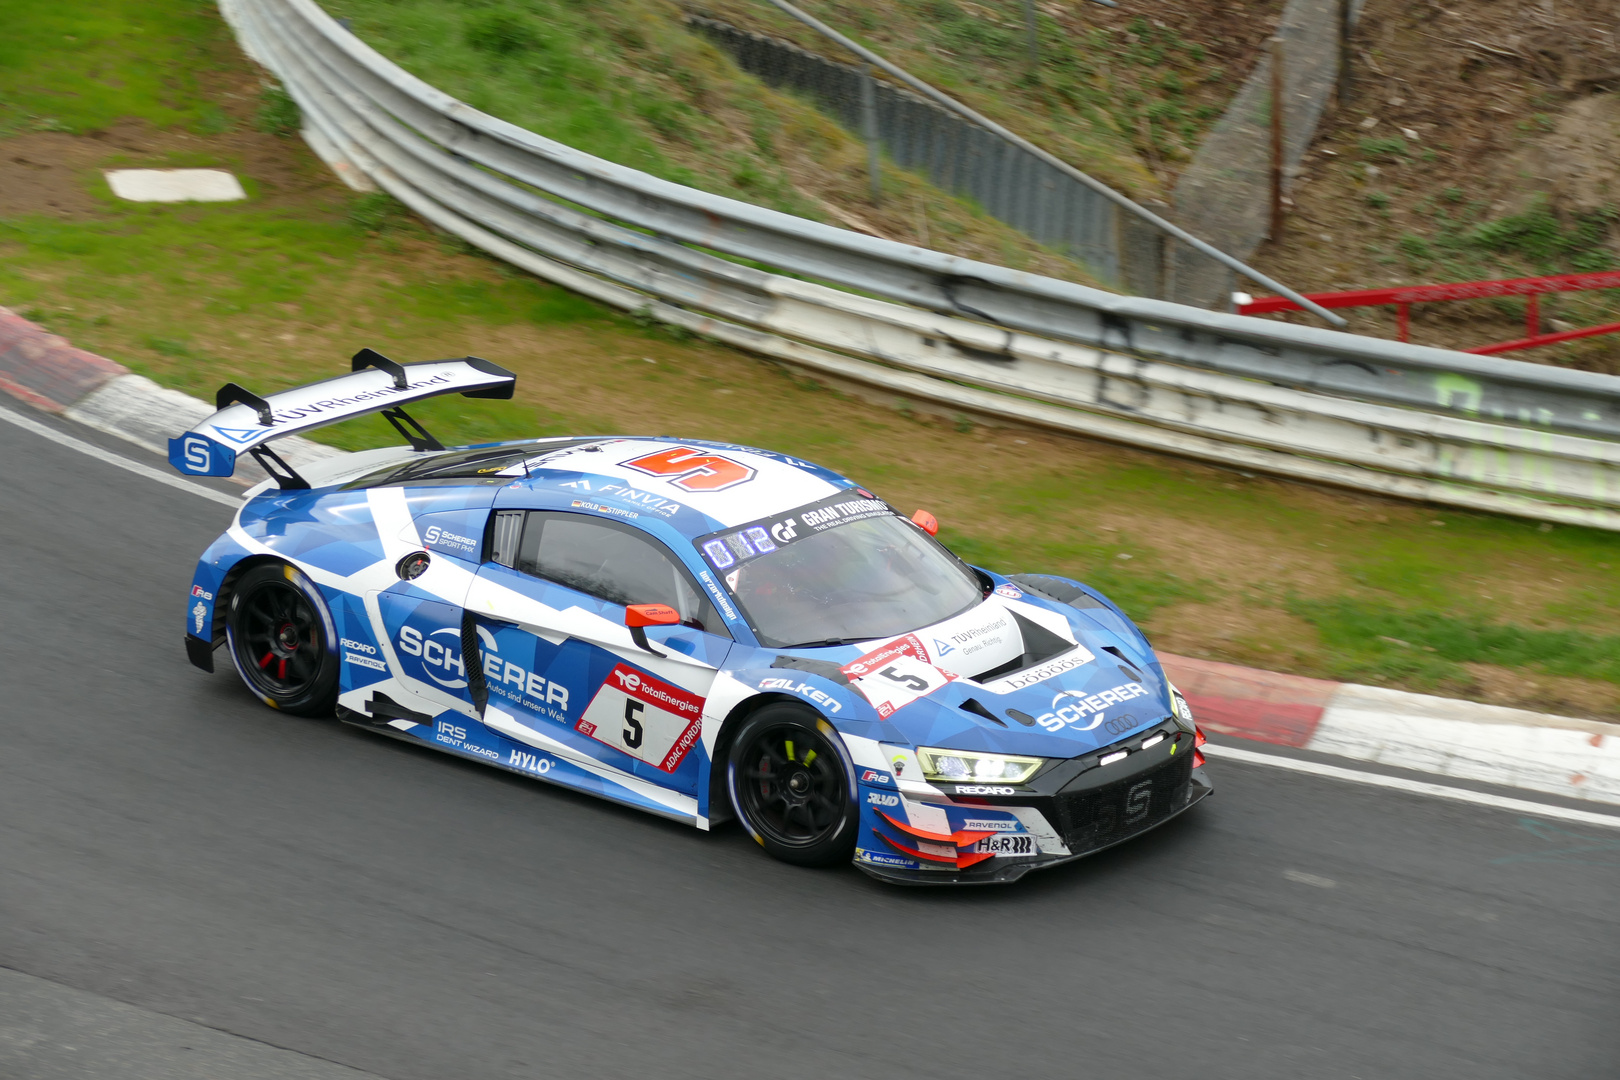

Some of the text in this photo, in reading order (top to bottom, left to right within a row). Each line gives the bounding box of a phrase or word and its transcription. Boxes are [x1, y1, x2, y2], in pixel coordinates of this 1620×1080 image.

[598, 484, 681, 514] FINVIA
[622, 498, 672, 517] FAMILY OFFICE
[580, 501, 639, 519] KOLB STIPPLER
[801, 499, 889, 527] GRAN TURISMO
[828, 519, 844, 528] REAL
[842, 514, 866, 524] DRIVING
[439, 538, 475, 553] SPORT PHX
[441, 531, 477, 546] SCHERER
[194, 586, 213, 600] R8
[951, 617, 1007, 644] TÜVRheinland
[340, 637, 376, 655] RECARO
[962, 644, 984, 655] Genau.
[349, 655, 382, 668] RAVENOL
[400, 625, 569, 711] SCHERER
[878, 666, 929, 691] 5
[1005, 657, 1084, 689] böööös
[486, 681, 567, 724] Autos sind unsere Welt.
[640, 682, 699, 713] TotalEnergies
[758, 678, 842, 713] FALKEN
[1036, 682, 1149, 732] SCHERER
[438, 721, 467, 740] IRS
[623, 698, 644, 750] 5
[436, 734, 499, 759] DENT WIZARD
[666, 746, 683, 771] ADAC
[864, 771, 890, 783] R8
[955, 785, 1015, 796] RECARO
[978, 836, 1011, 853] H&R
[873, 856, 914, 866] MICHELIN
